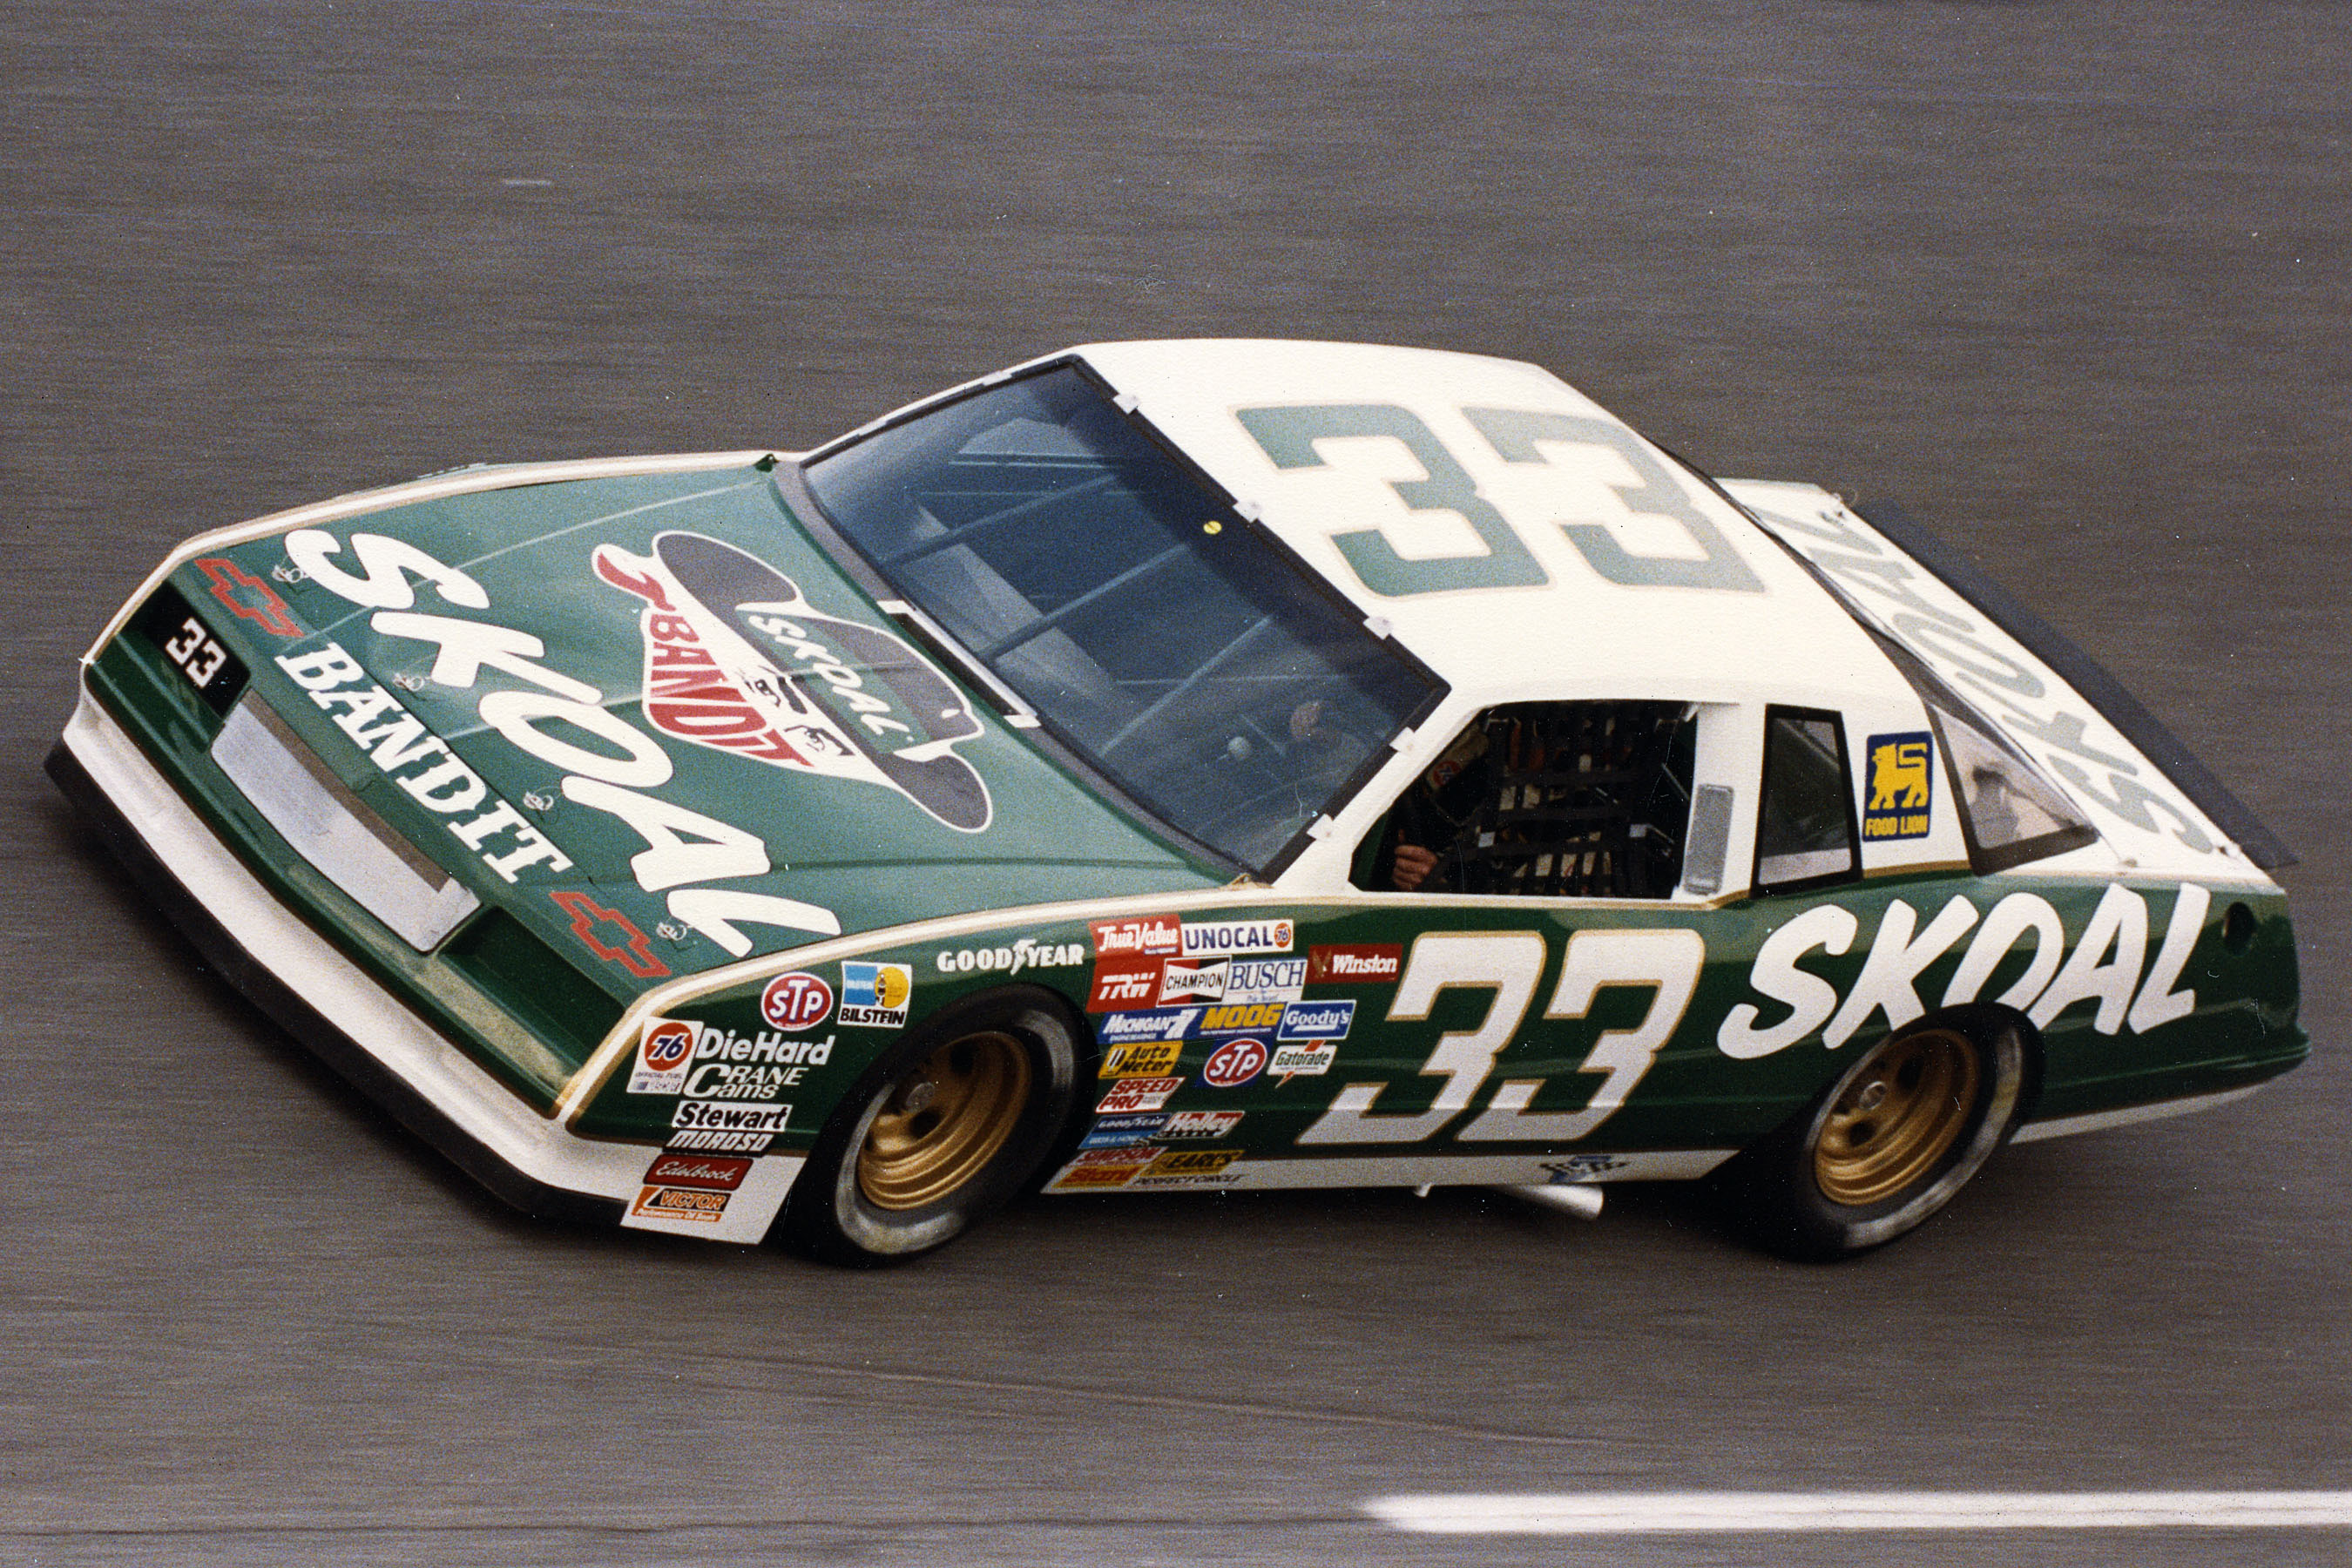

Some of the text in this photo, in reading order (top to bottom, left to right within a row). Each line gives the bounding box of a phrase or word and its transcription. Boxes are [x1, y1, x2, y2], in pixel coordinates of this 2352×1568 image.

[1231, 402, 1768, 598] 33
[166, 618, 227, 688] 33
[748, 614, 909, 735] SKOAL
[1747, 505, 2213, 855] SKOAL
[648, 612, 815, 767] BANDIT
[284, 529, 841, 957] SKOAL
[274, 642, 573, 883] BANDIT
[1865, 814, 1929, 836] FOOD LION
[1185, 926, 1273, 950] UNOCAL
[936, 939, 1085, 975] GOODYEAR
[1332, 953, 1397, 975] Winston
[1717, 882, 2210, 1059] SKOAL
[1098, 971, 1156, 1001] TRW
[1166, 973, 1224, 990] CHAMPION
[1228, 962, 1306, 990] BUSCH
[769, 979, 824, 1021] STP
[840, 1007, 905, 1025] BILSTEIN
[1200, 1003, 1286, 1029] MOOG
[1286, 1009, 1351, 1026] Goody's
[648, 1032, 690, 1062] 76
[694, 1028, 836, 1065] DieHard
[1294, 929, 1707, 1146] 33
[1128, 1045, 1172, 1060] Auto
[1209, 1044, 1260, 1079] STP
[1274, 1051, 1330, 1066] Gatorade
[1116, 1060, 1174, 1075] Meter
[1111, 1078, 1179, 1095] SPEED
[675, 1102, 788, 1130] Stewart
[1099, 1094, 1144, 1111] PRO
[665, 1129, 775, 1152] MOROSO
[655, 1161, 740, 1182] Edelbrock
[659, 1190, 727, 1211] VICTOR
